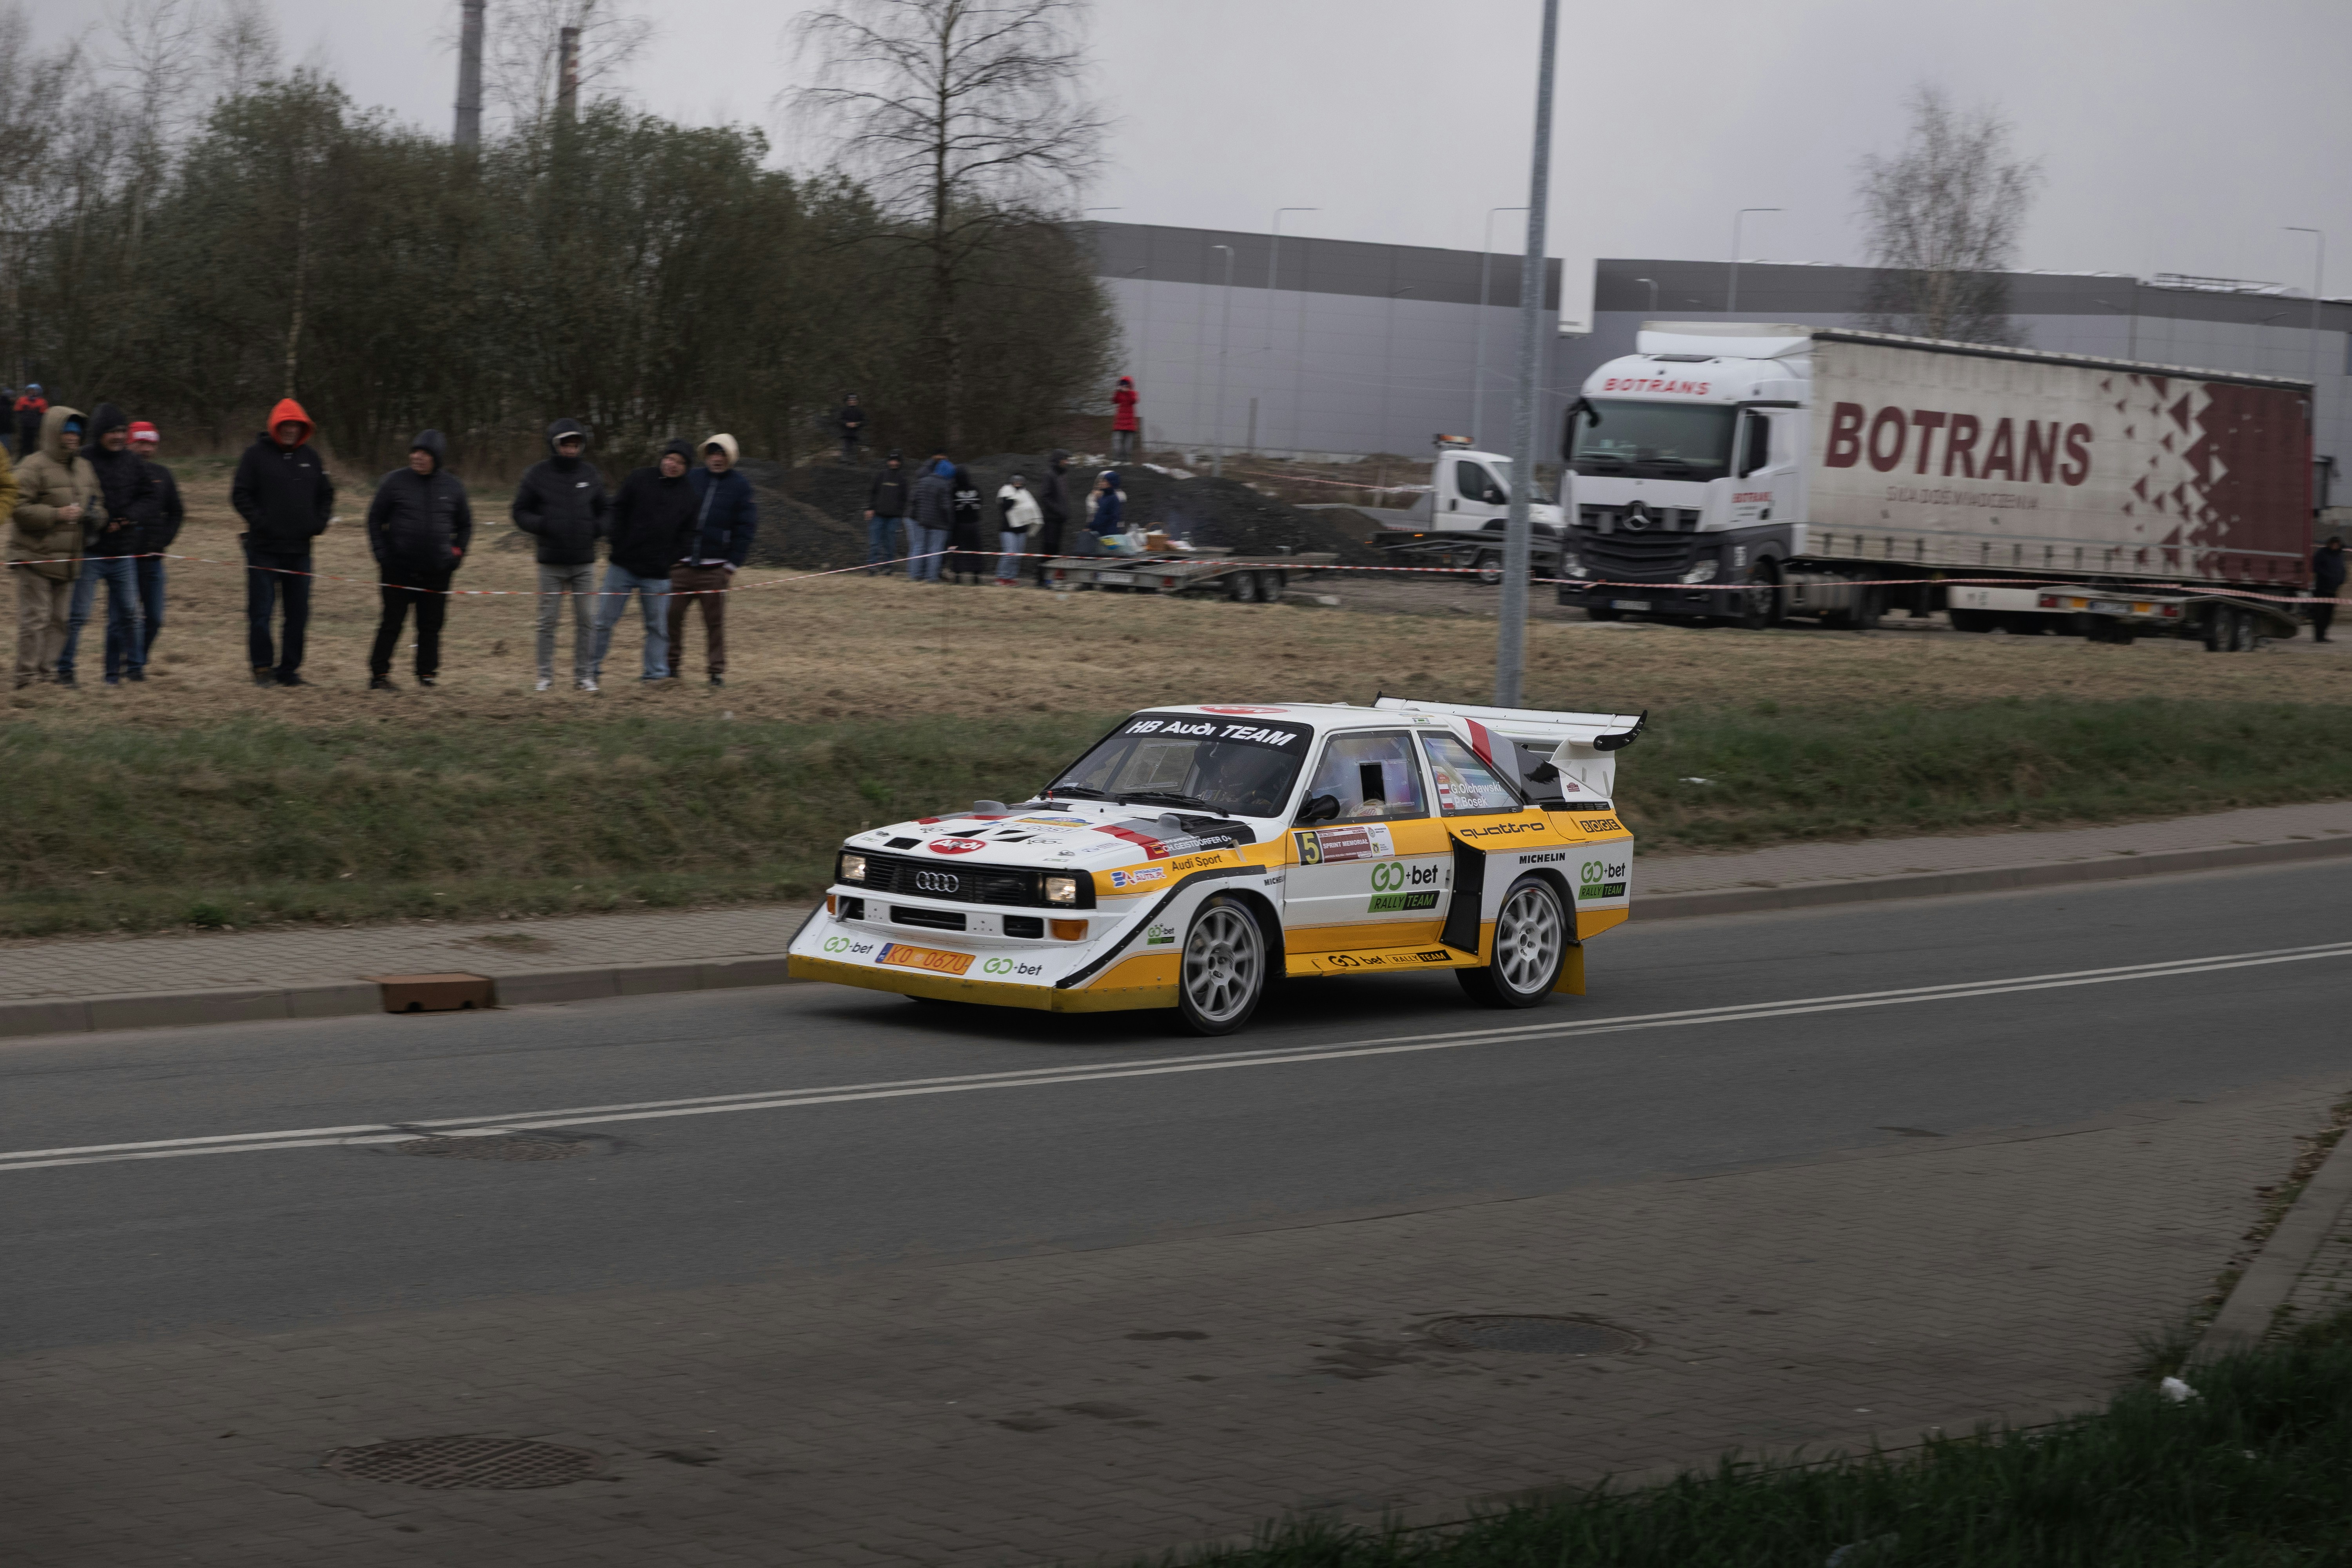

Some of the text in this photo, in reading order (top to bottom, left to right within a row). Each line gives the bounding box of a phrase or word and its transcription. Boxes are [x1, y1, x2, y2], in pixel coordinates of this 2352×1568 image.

[1602, 378, 1712, 395] BOTRANS
[1824, 401, 2094, 487] BOTRANS
[1125, 721, 1297, 746] HB Audi TEAM
[1451, 782, 1501, 794] G.Olchawski
[1454, 796, 1488, 808] P.Bosek
[1460, 822, 1545, 838] quattro
[1581, 820, 1621, 832] BOGE
[1302, 832, 1320, 864] 5
[1342, 838, 1369, 847] MEMORIAŁ
[1172, 854, 1223, 871] Audi Sport
[1519, 852, 1566, 864] MICHELIN
[1581, 885, 1622, 897] RALLY TEAM
[1374, 894, 1434, 909] RALLY TEAM
[1328, 955, 1361, 967] GO
[1359, 956, 1387, 964] bet
[1419, 952, 1446, 960] TEAM
